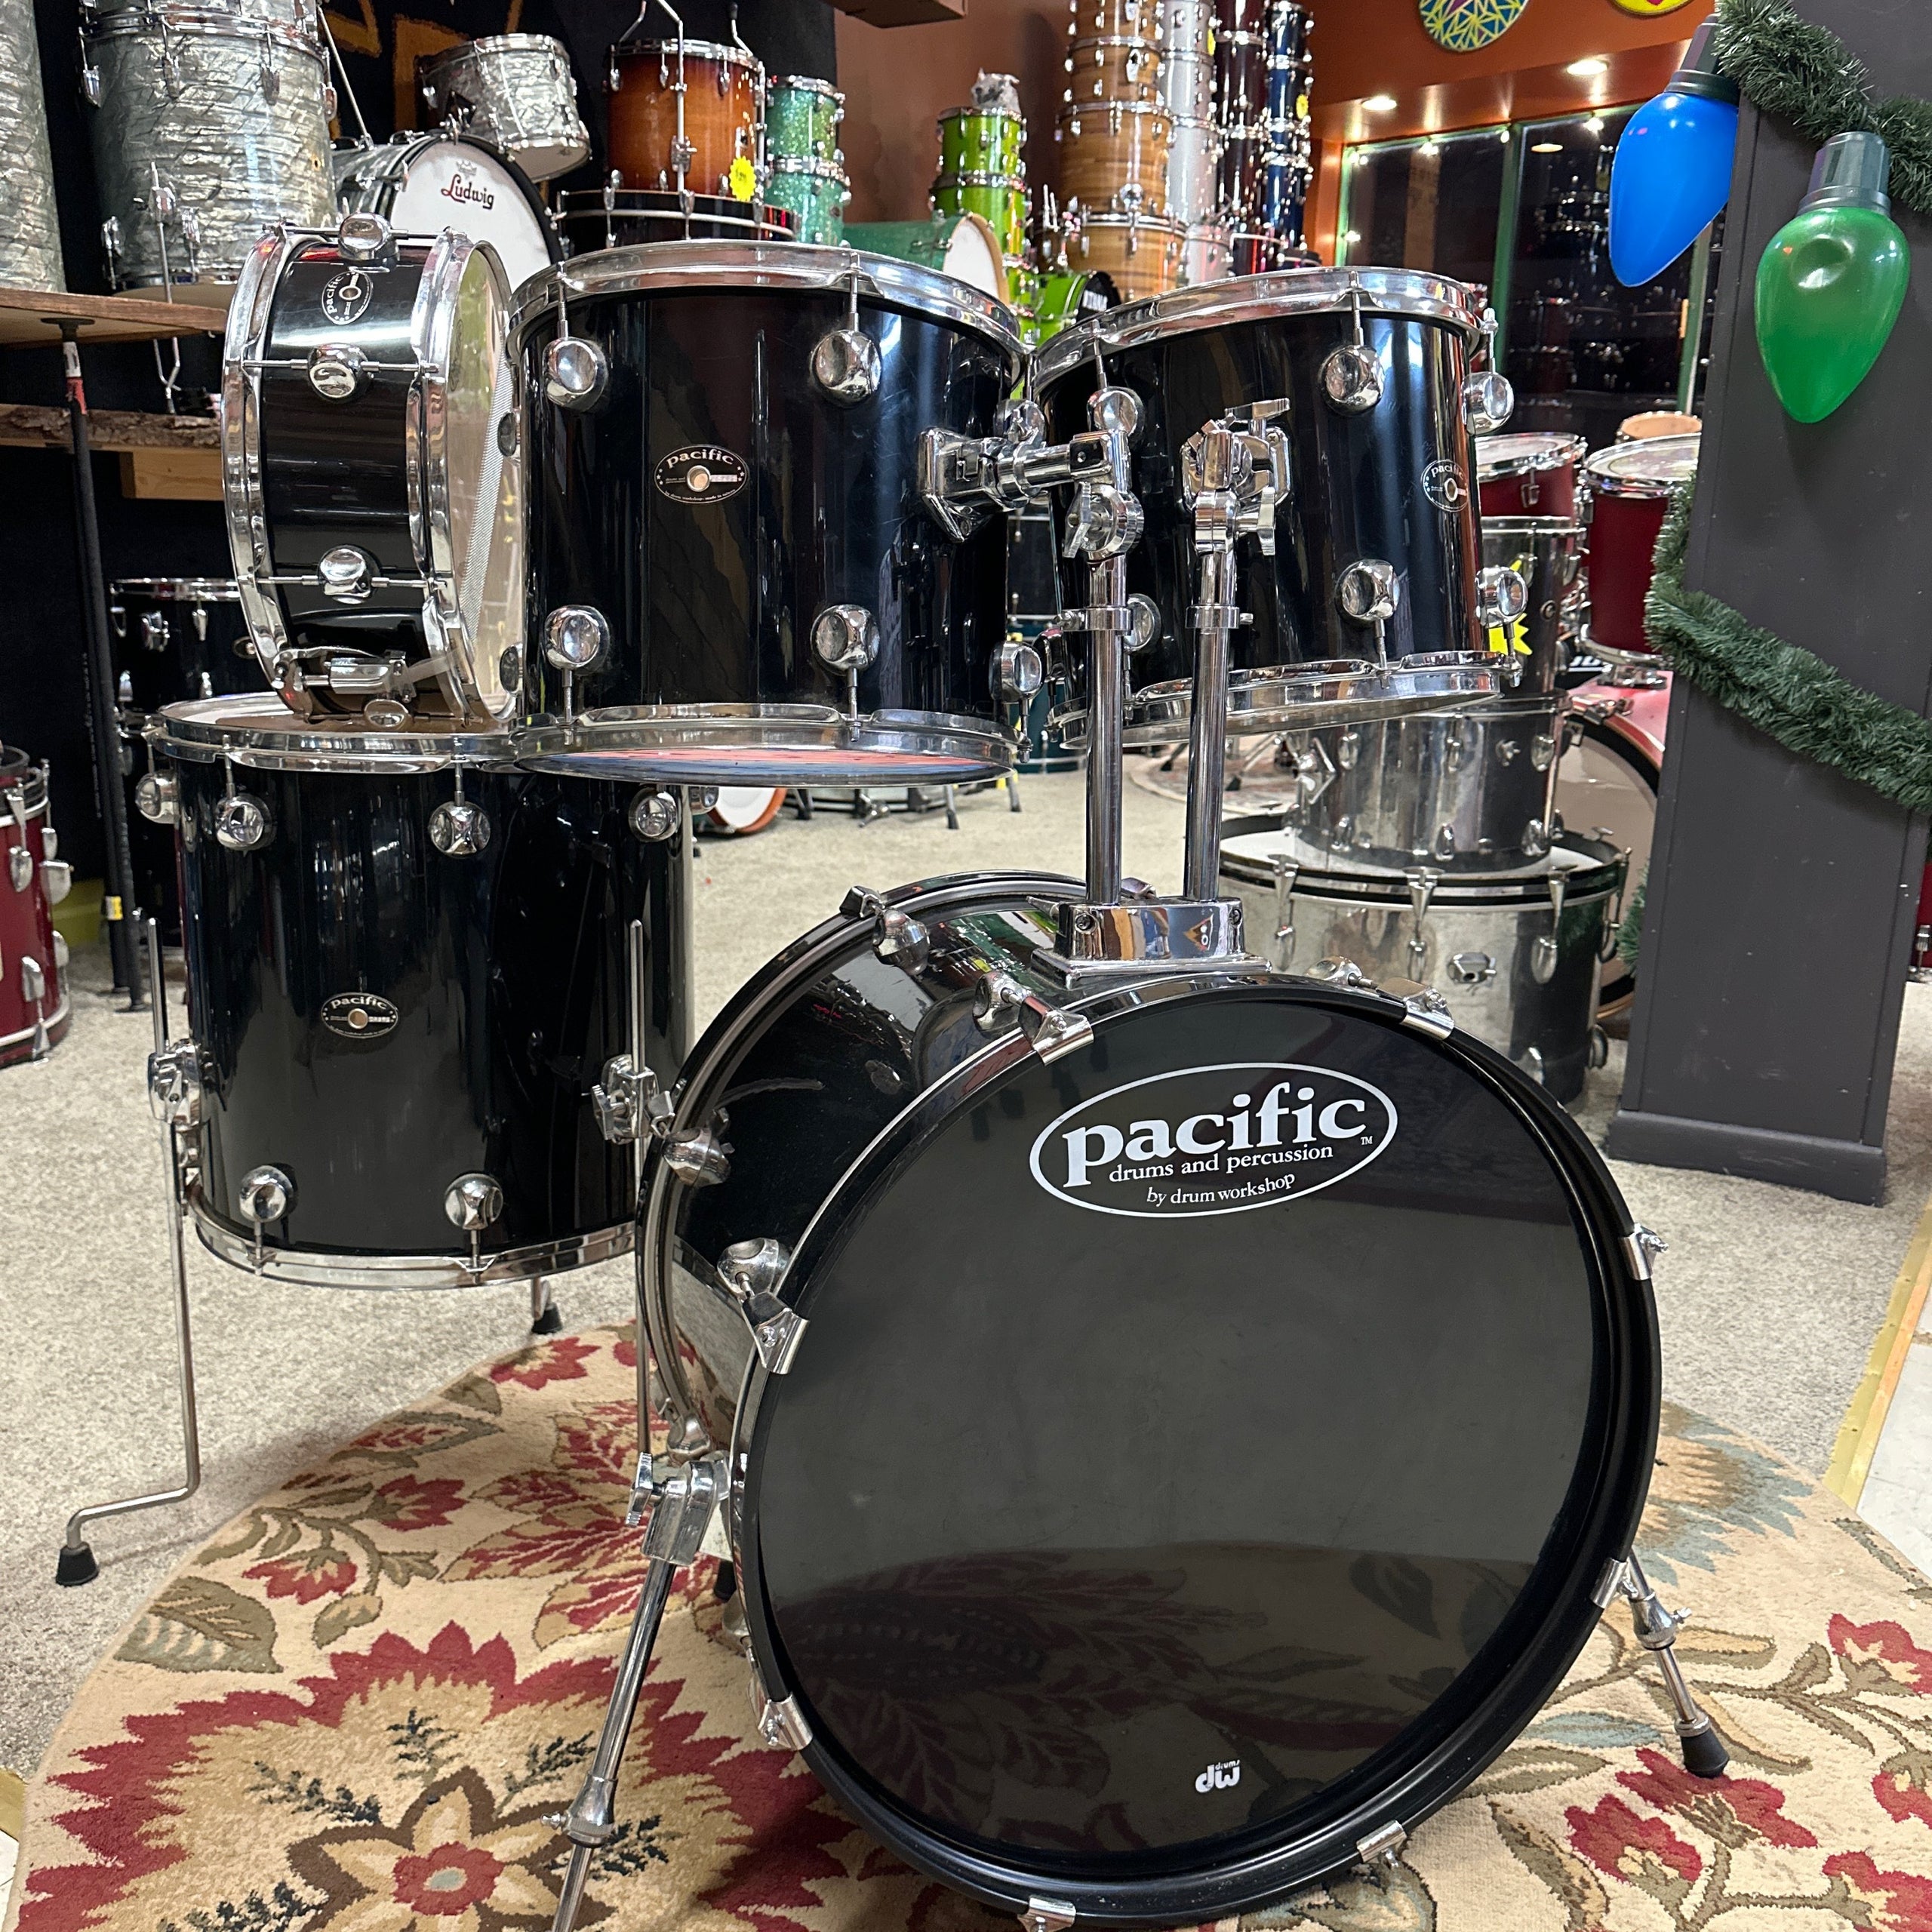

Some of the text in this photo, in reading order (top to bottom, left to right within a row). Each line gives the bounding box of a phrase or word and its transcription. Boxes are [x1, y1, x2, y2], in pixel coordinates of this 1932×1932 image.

[441, 174, 494, 210] Ludwig
[326, 275, 344, 314] pacific
[666, 448, 734, 469] pacific
[331, 996, 387, 1010] pacific
[1062, 1081, 1367, 1187] pacific
[1109, 1143, 1334, 1183] drums and percussion
[1146, 1174, 1295, 1208] by drum workshop
[1195, 1764, 1240, 1793] dw
